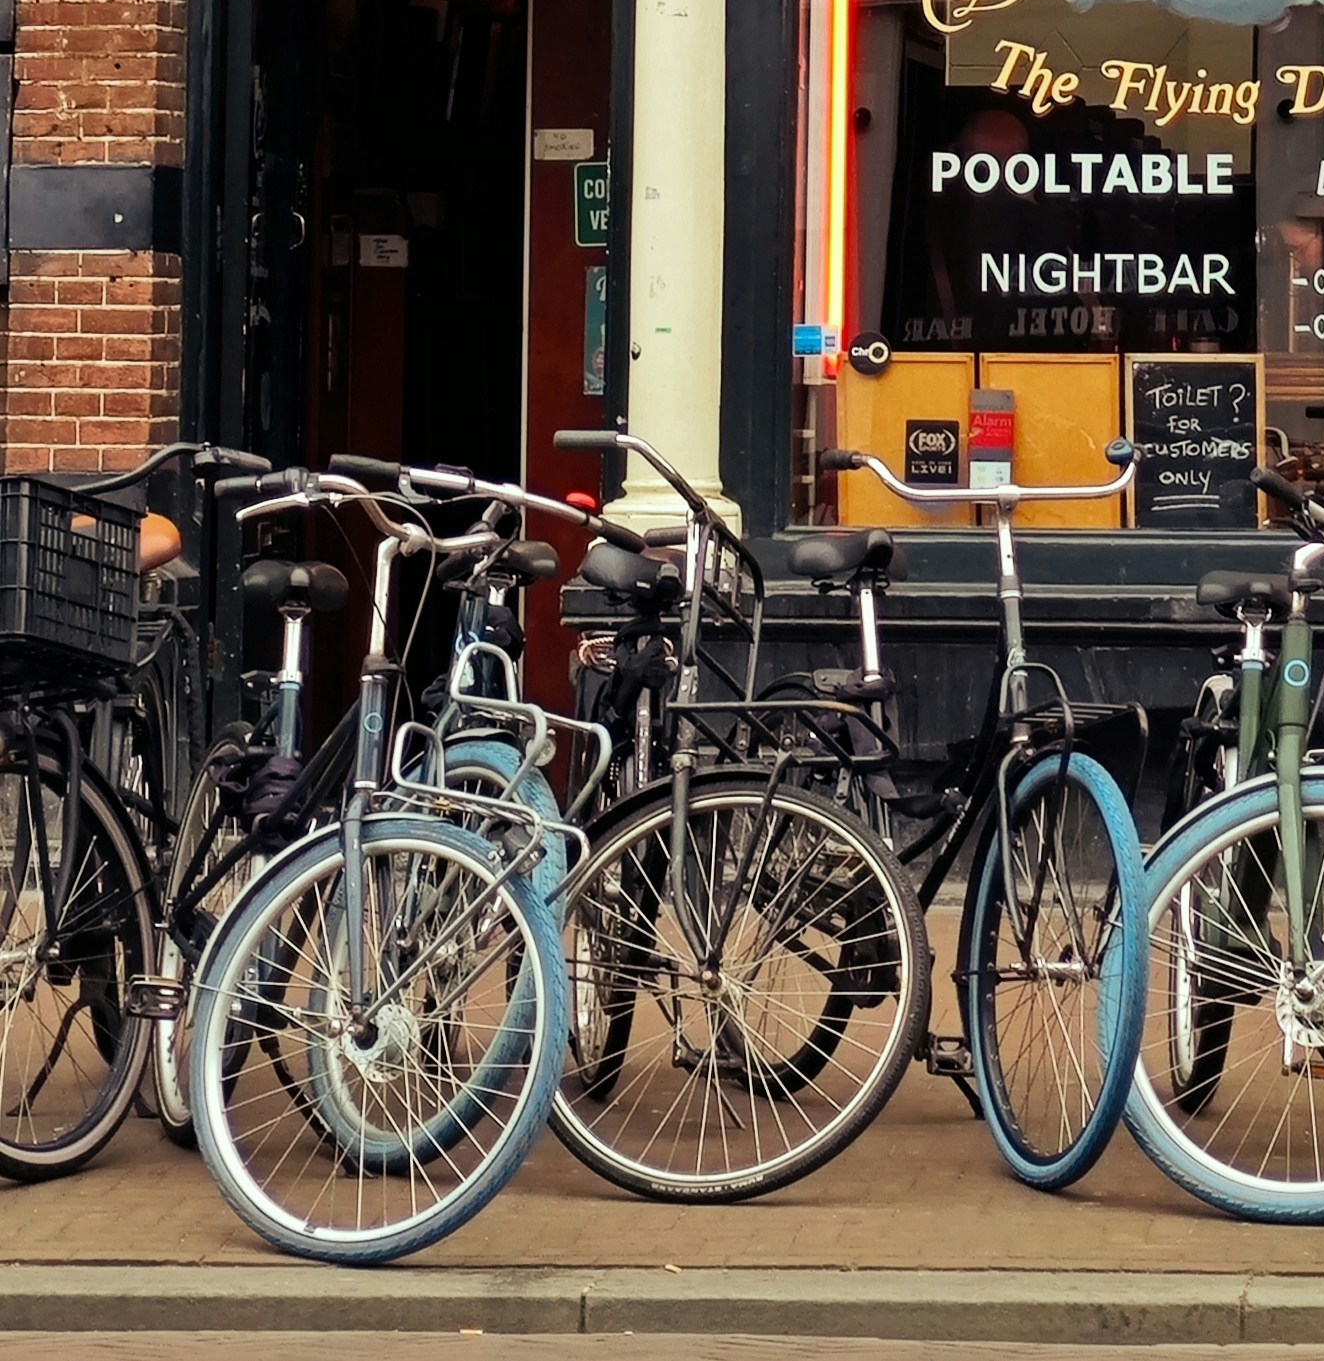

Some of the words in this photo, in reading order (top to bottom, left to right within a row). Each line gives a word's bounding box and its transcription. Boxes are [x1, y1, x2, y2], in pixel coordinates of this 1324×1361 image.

[990, 39, 1081, 116] The
[1100, 59, 1262, 127] Flying
[932, 152, 1234, 195] POOLTABLE
[980, 252, 1237, 296] NIGHTBAR
[918, 432, 947, 447] FOX
[973, 414, 1012, 427] Alarm
